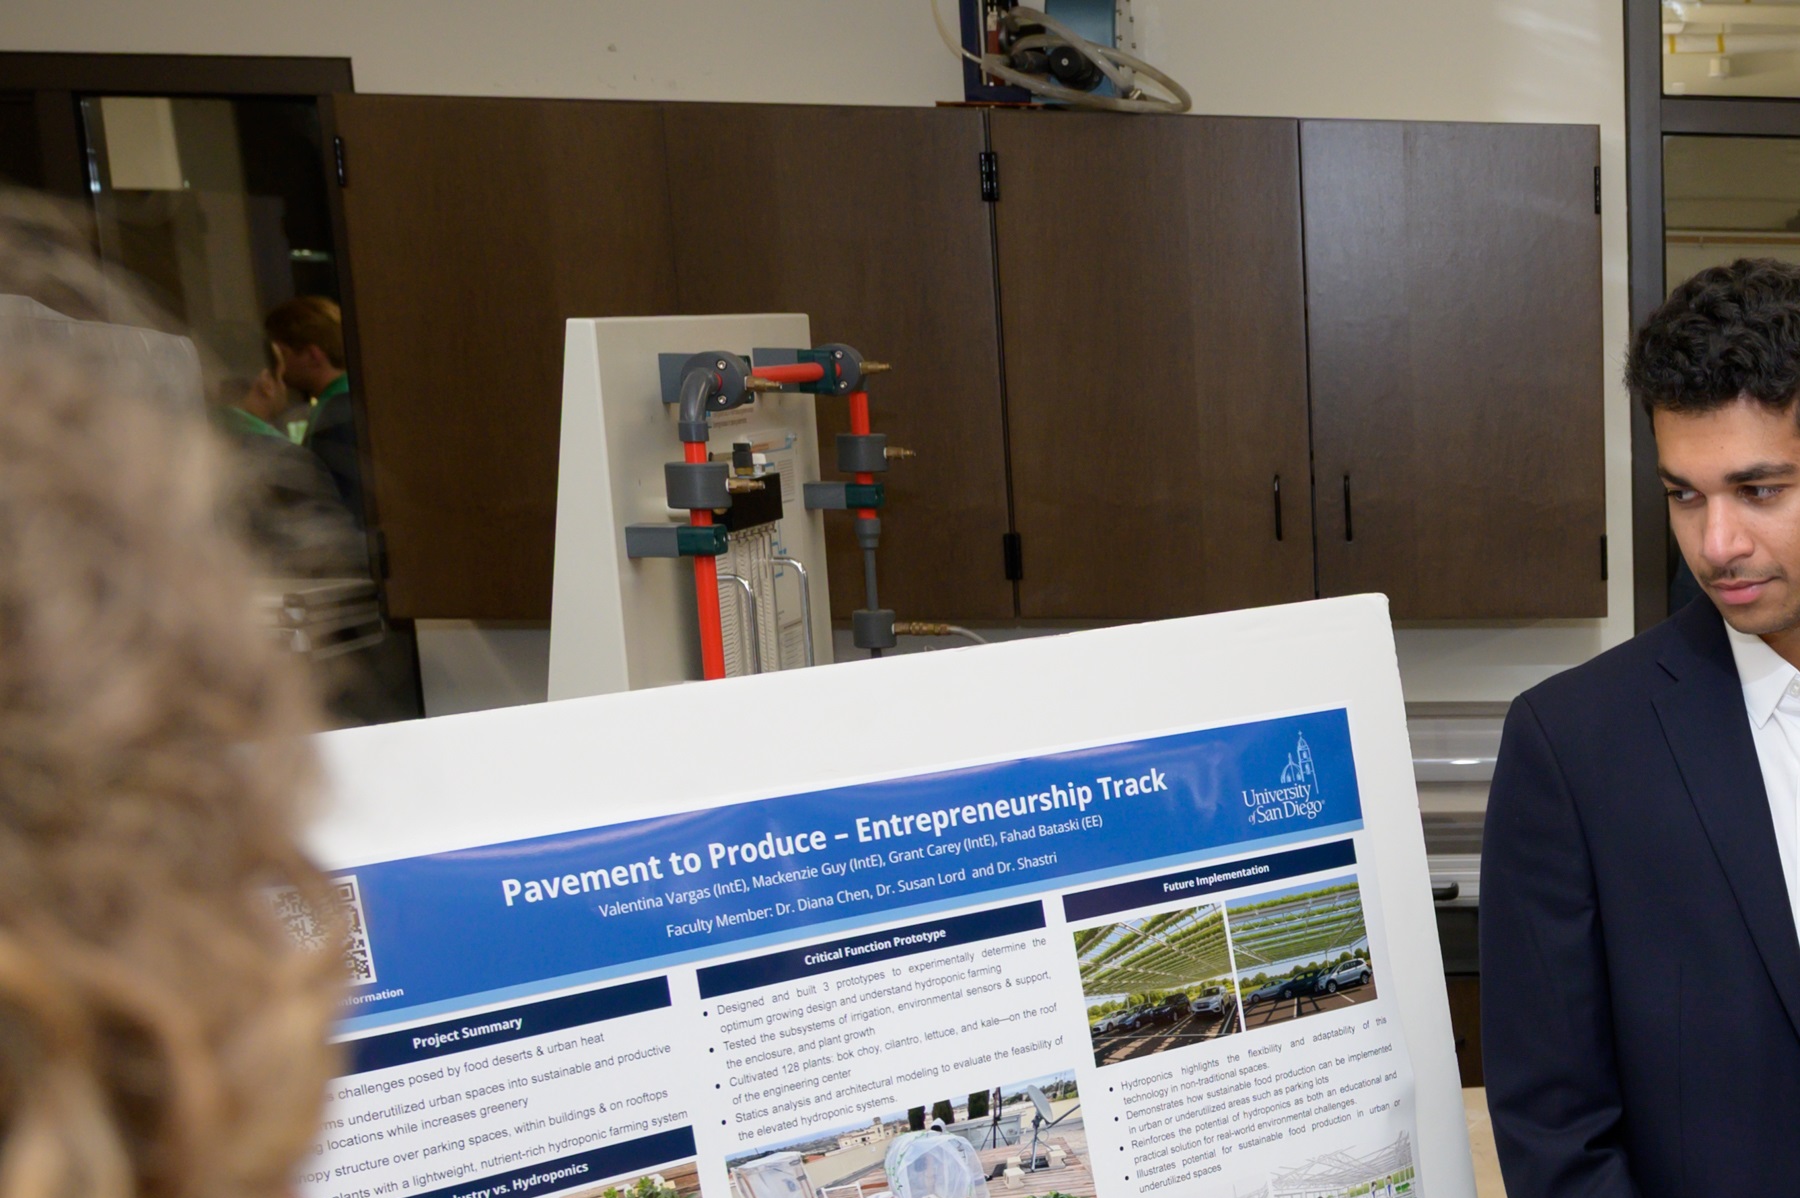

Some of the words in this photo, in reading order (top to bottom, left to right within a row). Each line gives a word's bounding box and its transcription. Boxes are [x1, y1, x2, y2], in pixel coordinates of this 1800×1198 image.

[1242, 783, 1312, 808] University
[1248, 809, 1257, 826] of
[1256, 804, 1283, 824] San
[1283, 799, 1323, 820] Diego
[500, 855, 664, 907] Pavement
[667, 851, 702, 876] to
[707, 829, 827, 869] Produce
[854, 781, 1093, 843] Entrepreneurship
[1095, 767, 1168, 801] Track
[597, 895, 664, 918] Valentina
[664, 887, 712, 905] Vargas
[712, 877, 750, 899] (IntE),
[751, 865, 819, 889] Mackenzie
[820, 861, 847, 877] Guy
[848, 853, 886, 873] (IntE),
[887, 846, 925, 864] Grant
[925, 841, 962, 857] Carey
[962, 833, 998, 853] (IntE),
[999, 825, 1037, 844] Fahad
[1037, 817, 1080, 837] Bataski
[1080, 813, 1103, 831] (EE)
[1162, 878, 1195, 893] Future
[1195, 864, 1270, 887] Implementation
[665, 917, 714, 938] Faculty
[714, 906, 774, 928] Member:
[774, 902, 796, 916] Dr.
[796, 894, 835, 912] Diana
[835, 888, 874, 904] Chen,
[874, 883, 896, 897] Dr.
[896, 876, 936, 893] Susan
[936, 867, 967, 885] Lord
[971, 861, 995, 879] and
[996, 860, 1016, 874] Dr.
[1016, 850, 1058, 871] Shastri
[803, 947, 844, 966] Critical
[843, 939, 893, 958] Function
[892, 928, 947, 947] Prototype
[716, 995, 765, 1016] Designed
[771, 989, 790, 1004] and
[795, 984, 818, 998] built
[822, 980, 830, 992] 3
[835, 970, 886, 991] prototypes
[891, 967, 902, 977] to
[907, 951, 975, 974] experimentally
[980, 941, 1027, 958] determine
[1031, 937, 1047, 948] the
[411, 1029, 461, 1050] Project
[460, 1017, 523, 1039] Summary
[1119, 1070, 1174, 1091] Hydroponics
[1180, 1058, 1220, 1076] highlights
[1225, 1053, 1241, 1064] the
[1246, 1043, 1283, 1058] flexibility
[1289, 1036, 1306, 1049] and
[1311, 1024, 1356, 1043] adaptability
[1361, 1019, 1370, 1030] of
[1374, 1016, 1388, 1027] this
[337, 1077, 406, 1100] challenges
[407, 1067, 445, 1088] posed
[445, 1065, 461, 1078] by
[462, 1057, 490, 1073] food
[491, 1049, 534, 1067] deserts
[535, 1044, 545, 1057] &
[546, 1039, 578, 1054] urban
[579, 1032, 605, 1047] heat
[491, 1183, 511, 1196] vs.
[511, 1162, 589, 1192] Hydroponics
